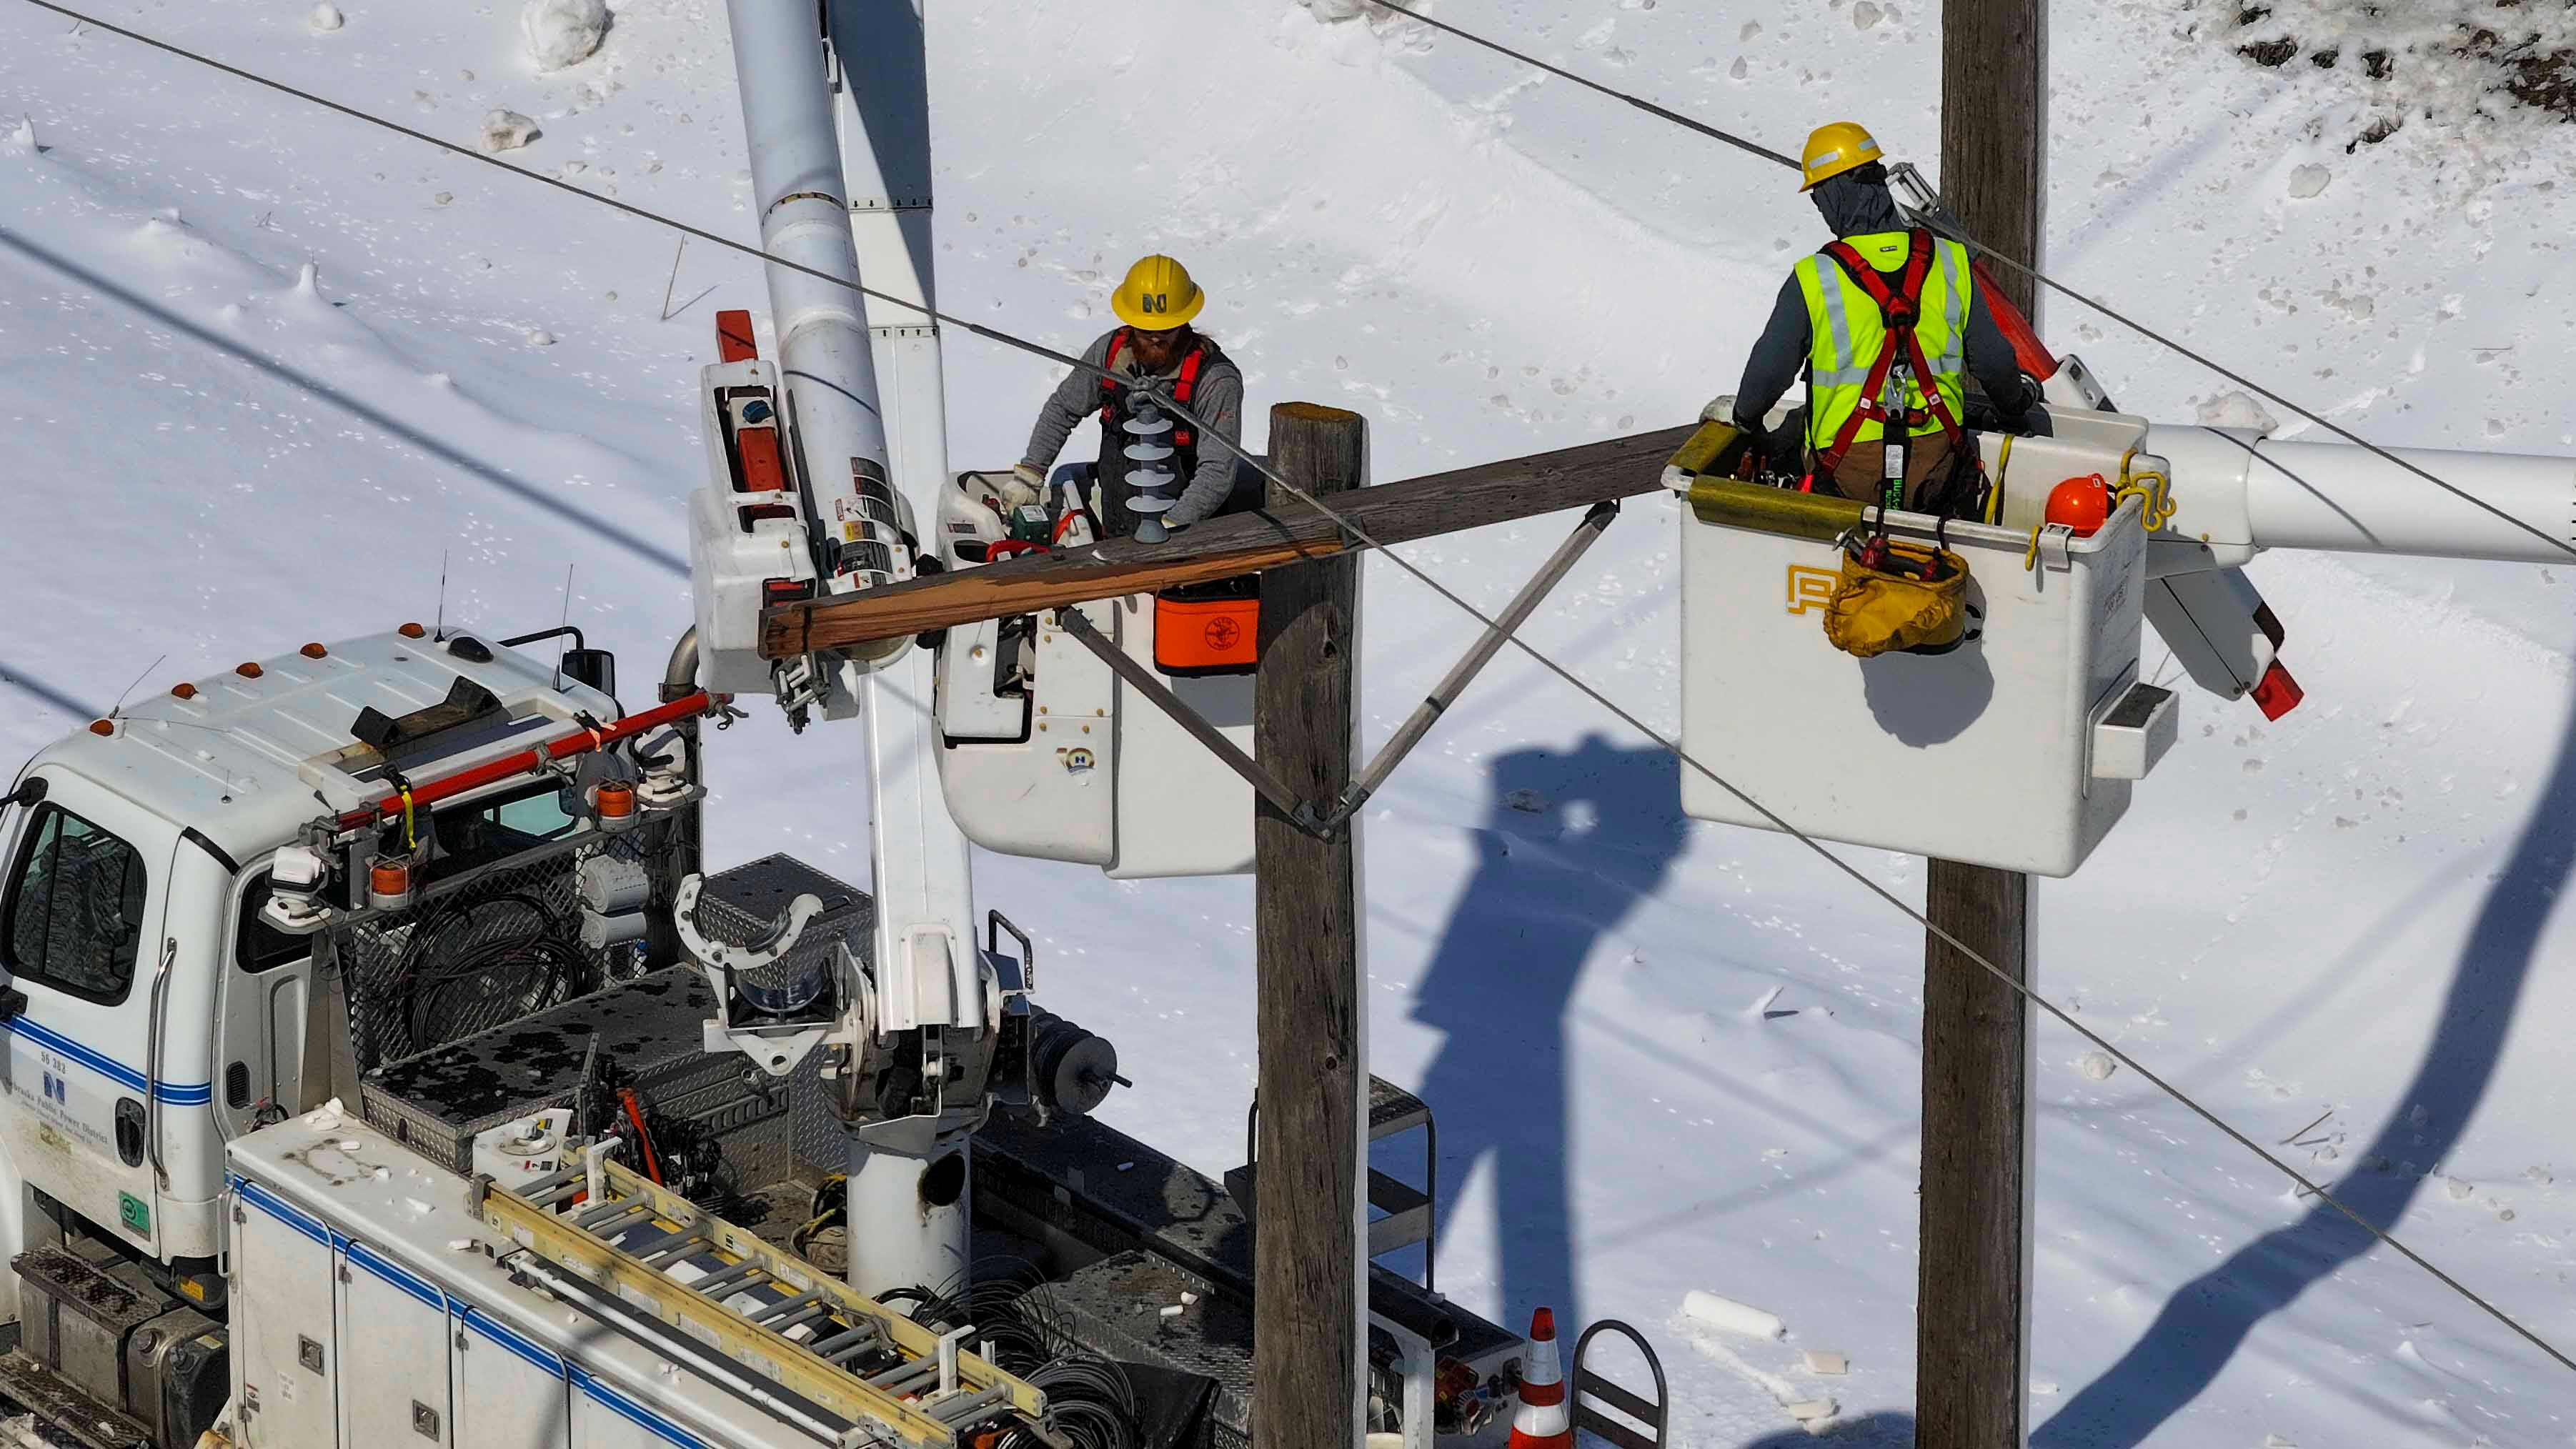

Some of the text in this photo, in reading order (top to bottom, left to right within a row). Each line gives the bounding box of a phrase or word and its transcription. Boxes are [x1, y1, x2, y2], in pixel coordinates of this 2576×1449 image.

[1143, 293, 1167, 314] N
[1075, 755, 1085, 764] N
[43, 1070, 65, 1106] N
